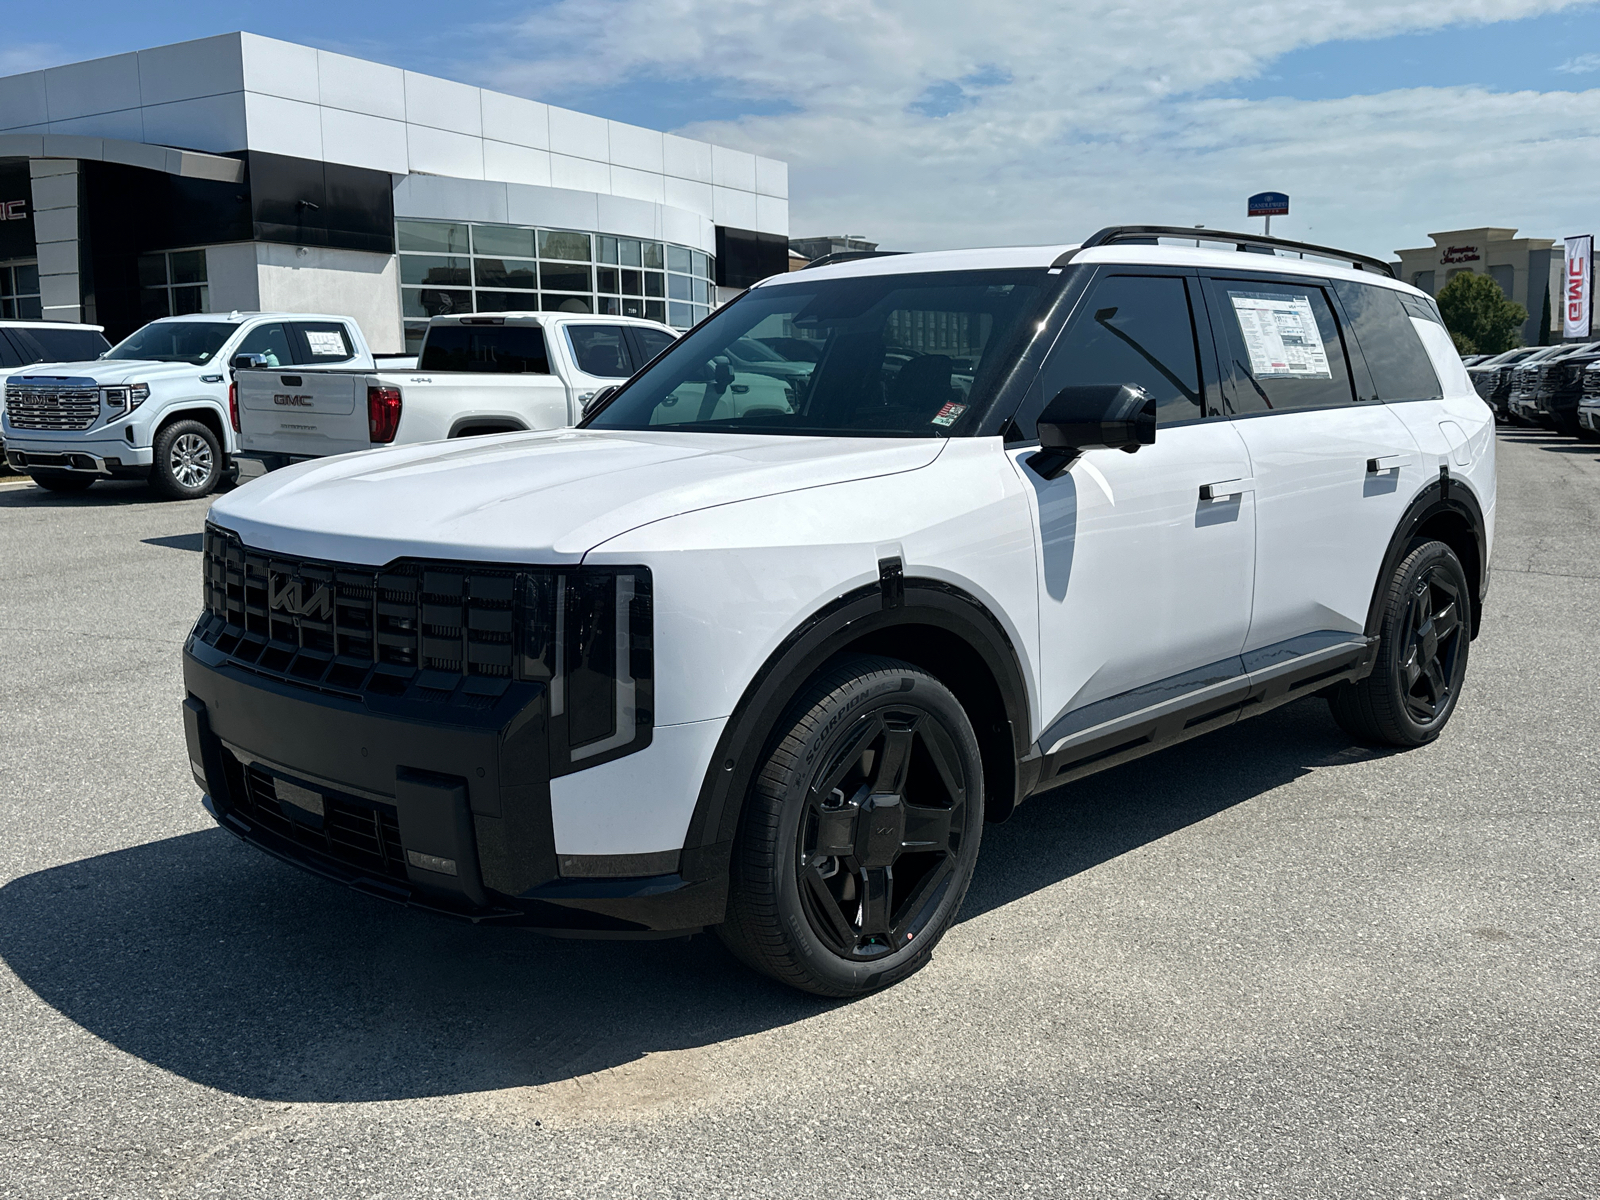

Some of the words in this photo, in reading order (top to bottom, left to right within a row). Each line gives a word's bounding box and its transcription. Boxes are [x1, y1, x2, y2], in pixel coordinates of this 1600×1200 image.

[1443, 246, 1477, 256] Hampton
[1568, 257, 1584, 321] GMC
[273, 394, 314, 407] GMC
[268, 574, 333, 620] KIA
[805, 689, 870, 765] SCORPION
